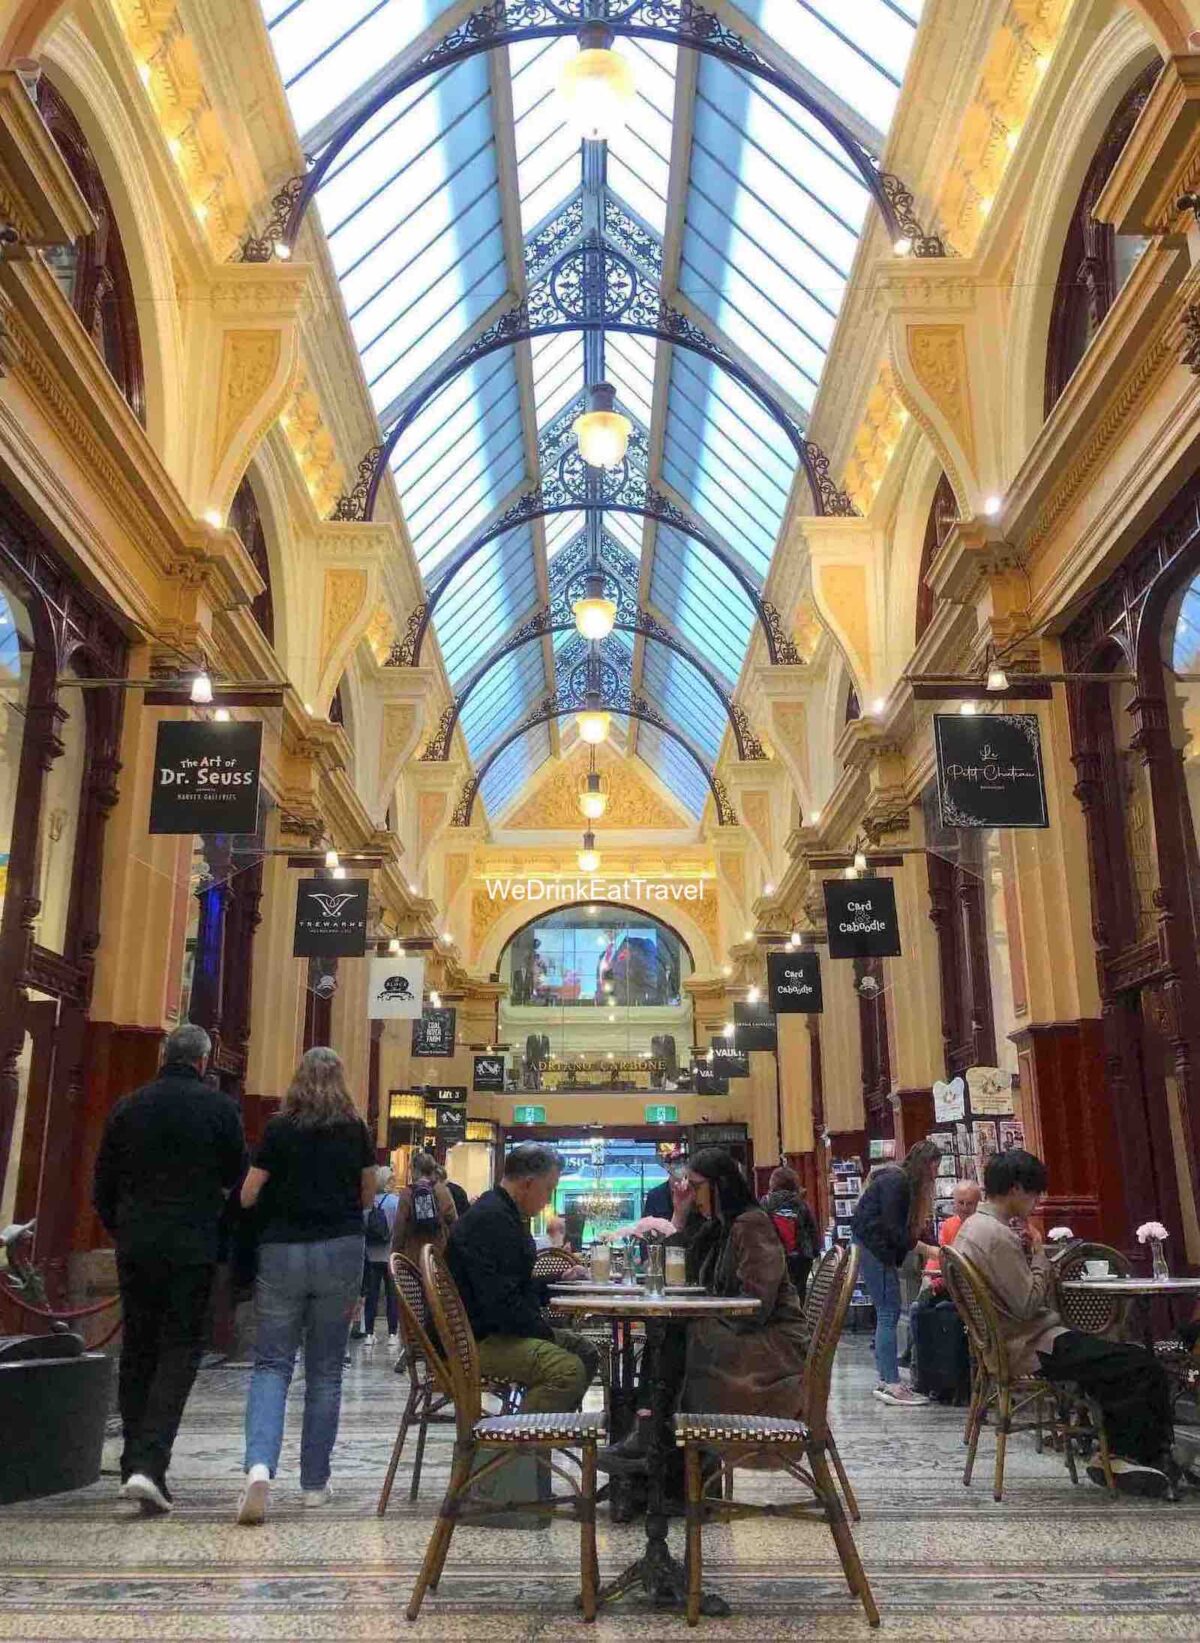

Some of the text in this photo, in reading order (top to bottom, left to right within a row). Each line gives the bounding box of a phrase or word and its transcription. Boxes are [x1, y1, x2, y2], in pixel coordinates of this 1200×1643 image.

[181, 756, 237, 768] The Art of
[160, 768, 253, 785] Dr. Seuss
[847, 900, 872, 911] Card
[839, 920, 886, 933] Caboodle
[784, 969, 804, 978] Card
[777, 984, 813, 995] Caboodle
